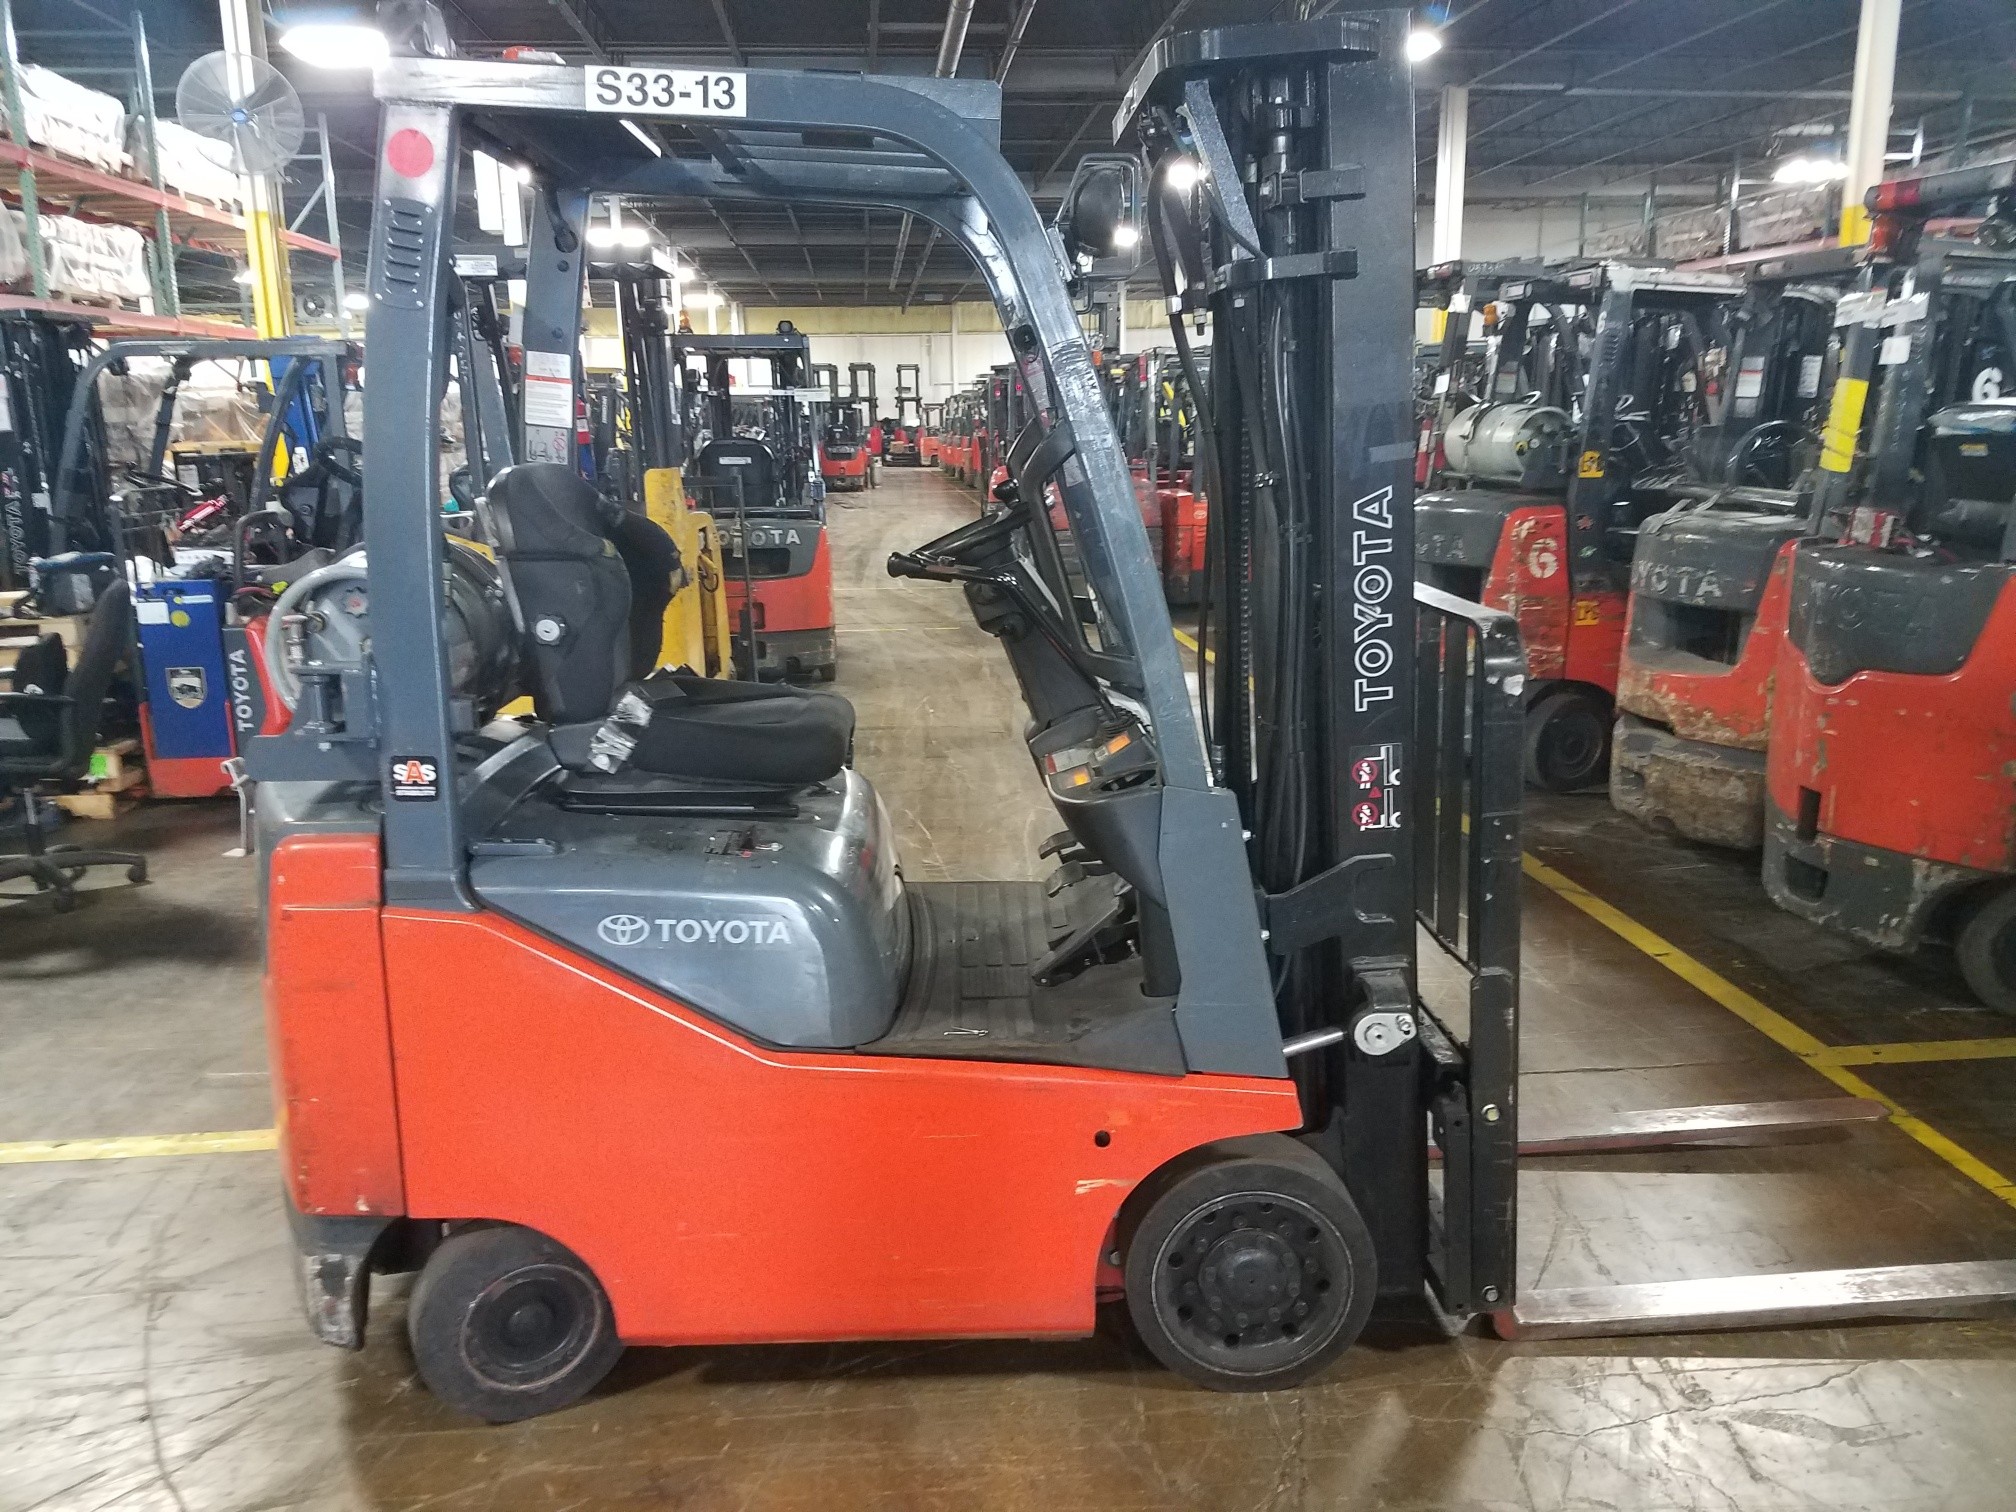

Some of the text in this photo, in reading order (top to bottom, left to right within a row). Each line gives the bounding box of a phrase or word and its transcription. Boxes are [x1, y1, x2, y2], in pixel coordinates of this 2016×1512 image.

[596, 69, 736, 110] S33-13
[715, 529, 801, 546] OOTA
[1353, 485, 1393, 712] TOYOTA
[229, 649, 254, 732] TOYOTA
[393, 760, 437, 784] SAS
[654, 918, 792, 945] TOYOTA
